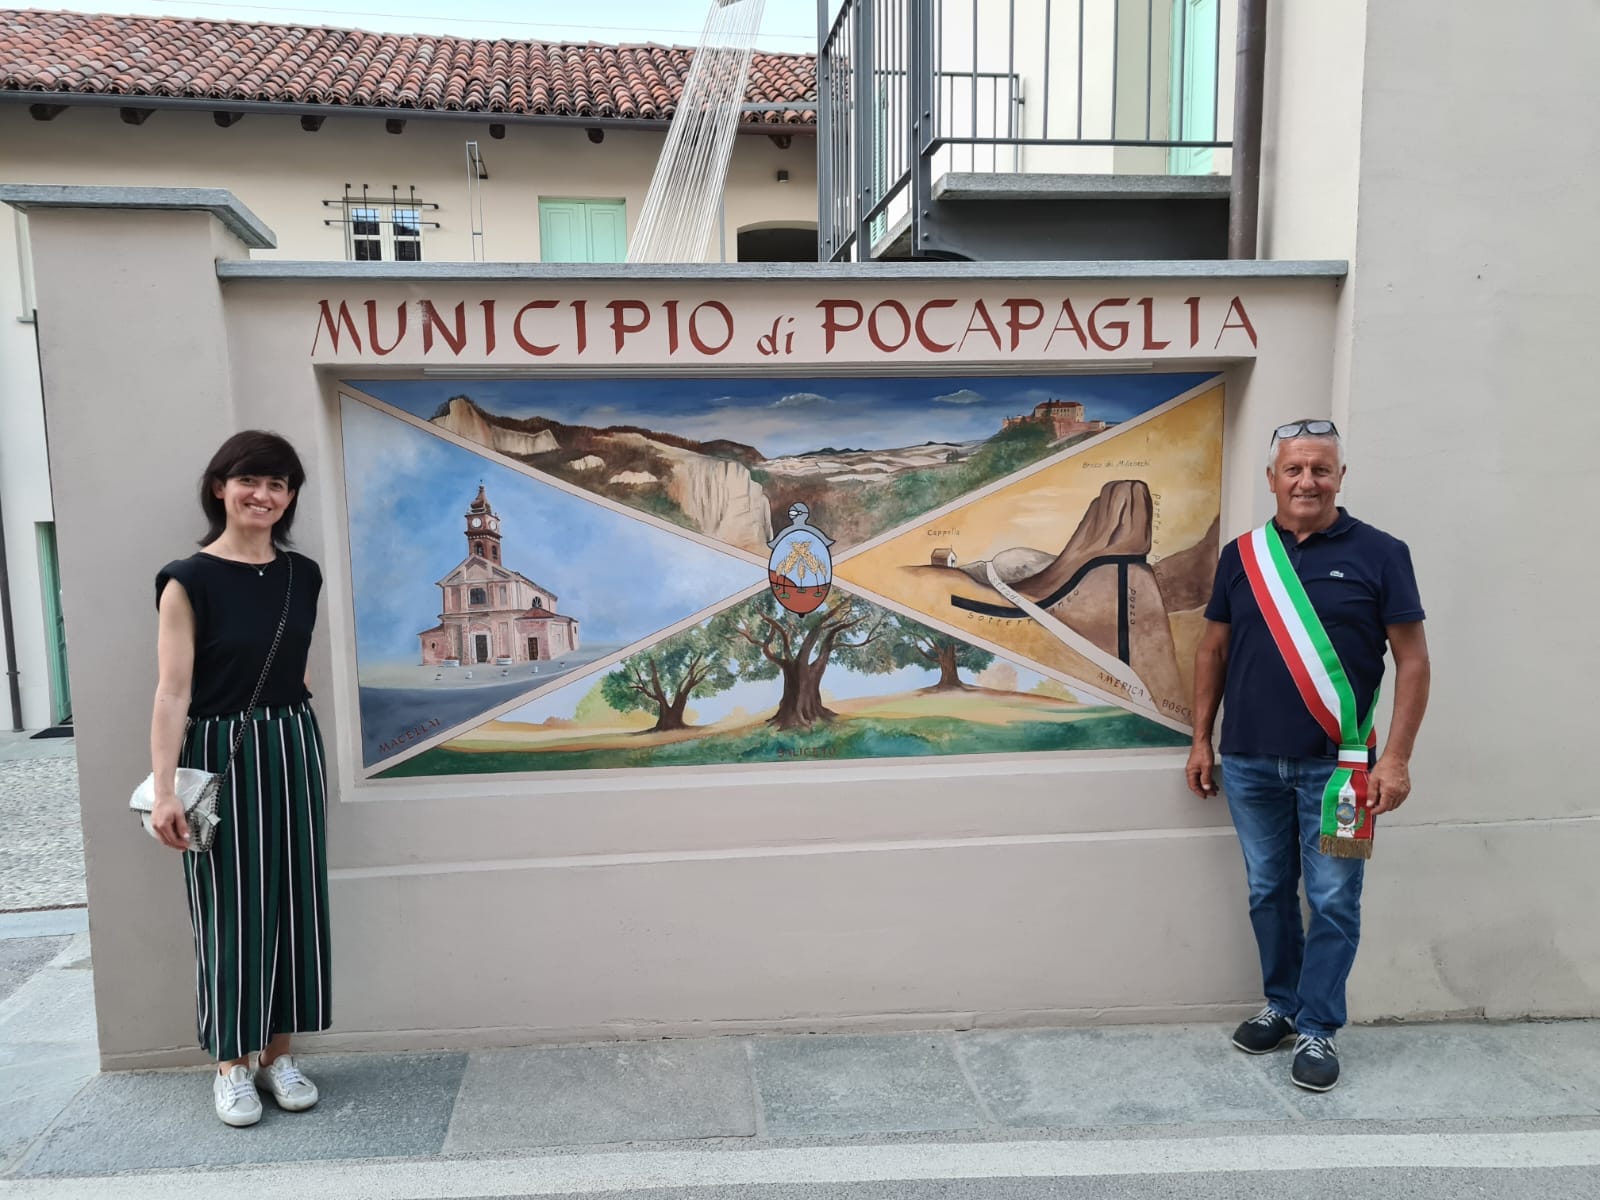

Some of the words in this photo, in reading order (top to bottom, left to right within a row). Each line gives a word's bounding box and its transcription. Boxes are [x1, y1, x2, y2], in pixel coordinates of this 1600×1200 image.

[311, 299, 734, 356] MUNICIPIO
[756, 313, 796, 356] di
[815, 296, 1258, 354] POCAPAGLIA
[927, 527, 961, 537] Cappella
[1097, 671, 1145, 697] AMERICA
